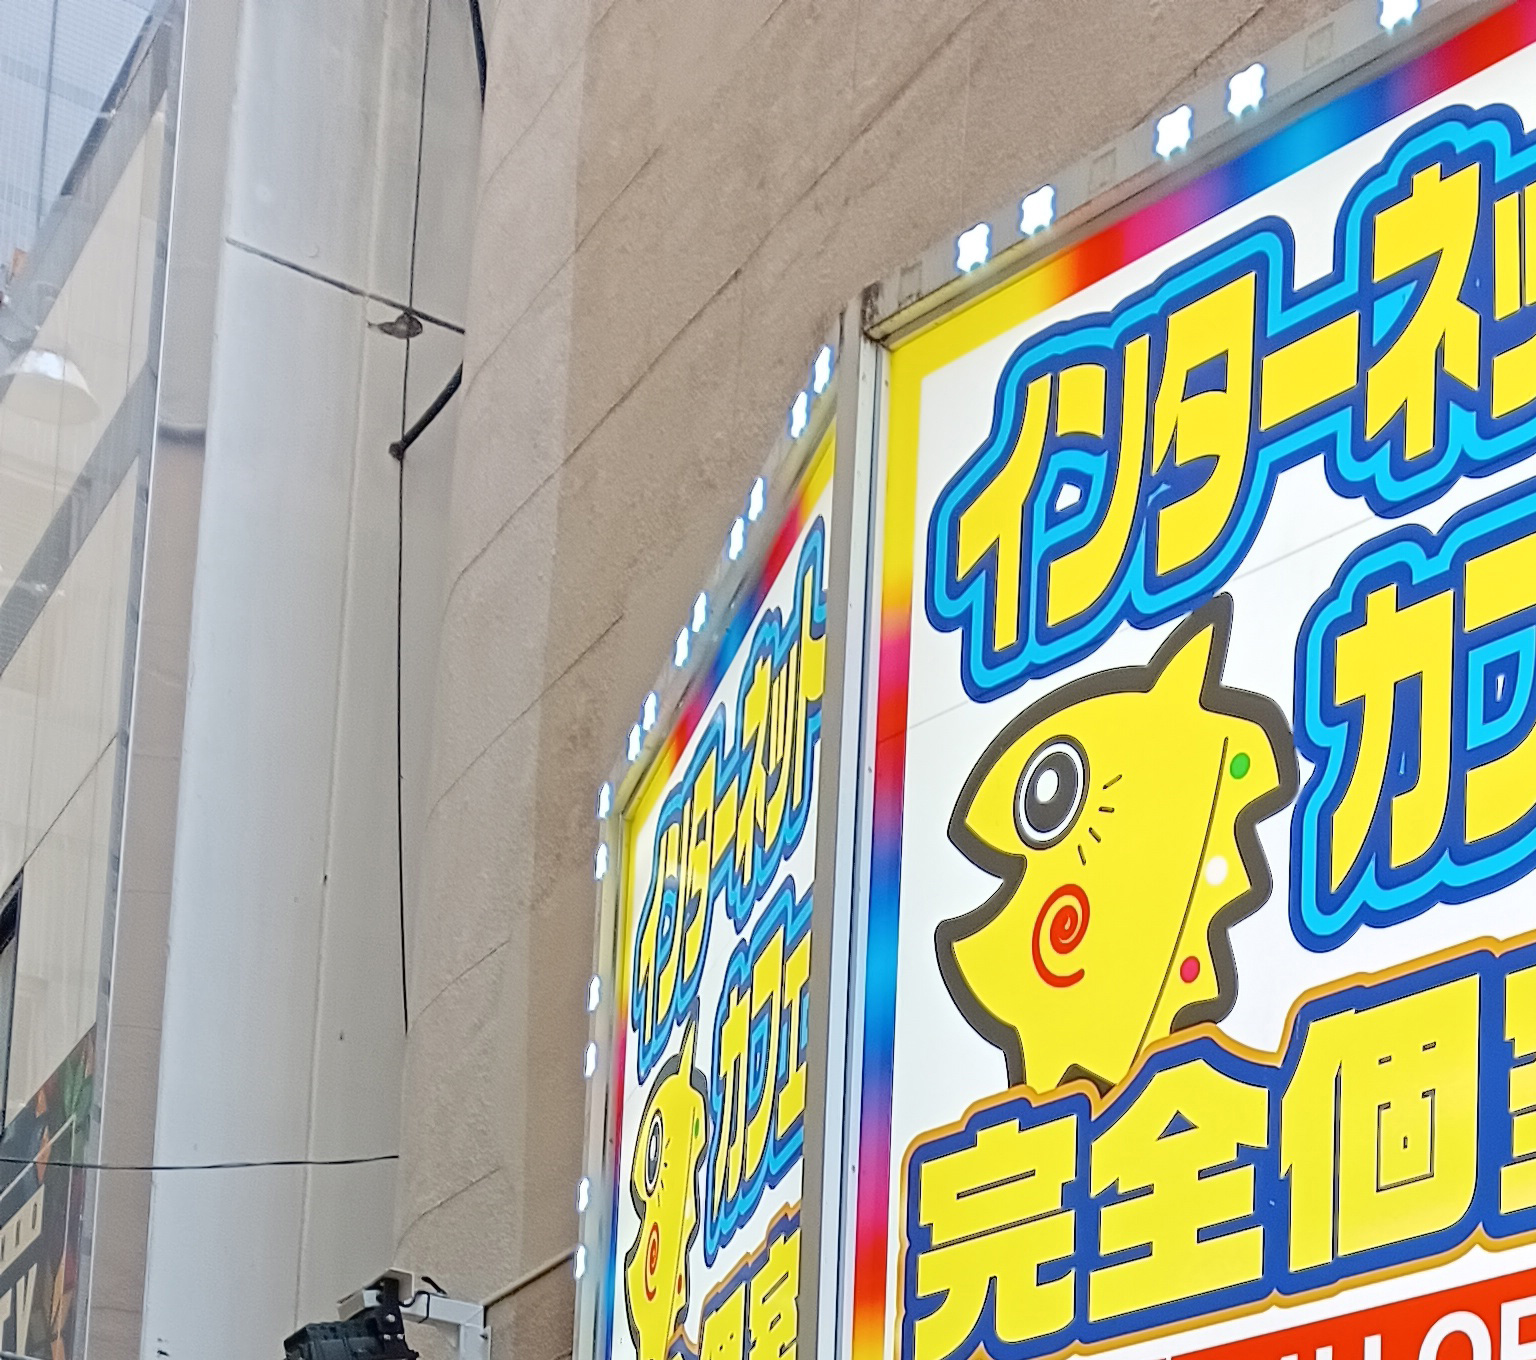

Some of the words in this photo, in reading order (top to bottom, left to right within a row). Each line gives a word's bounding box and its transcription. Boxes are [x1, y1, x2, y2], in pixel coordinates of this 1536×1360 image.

[634, 545, 826, 1065] インターネット
